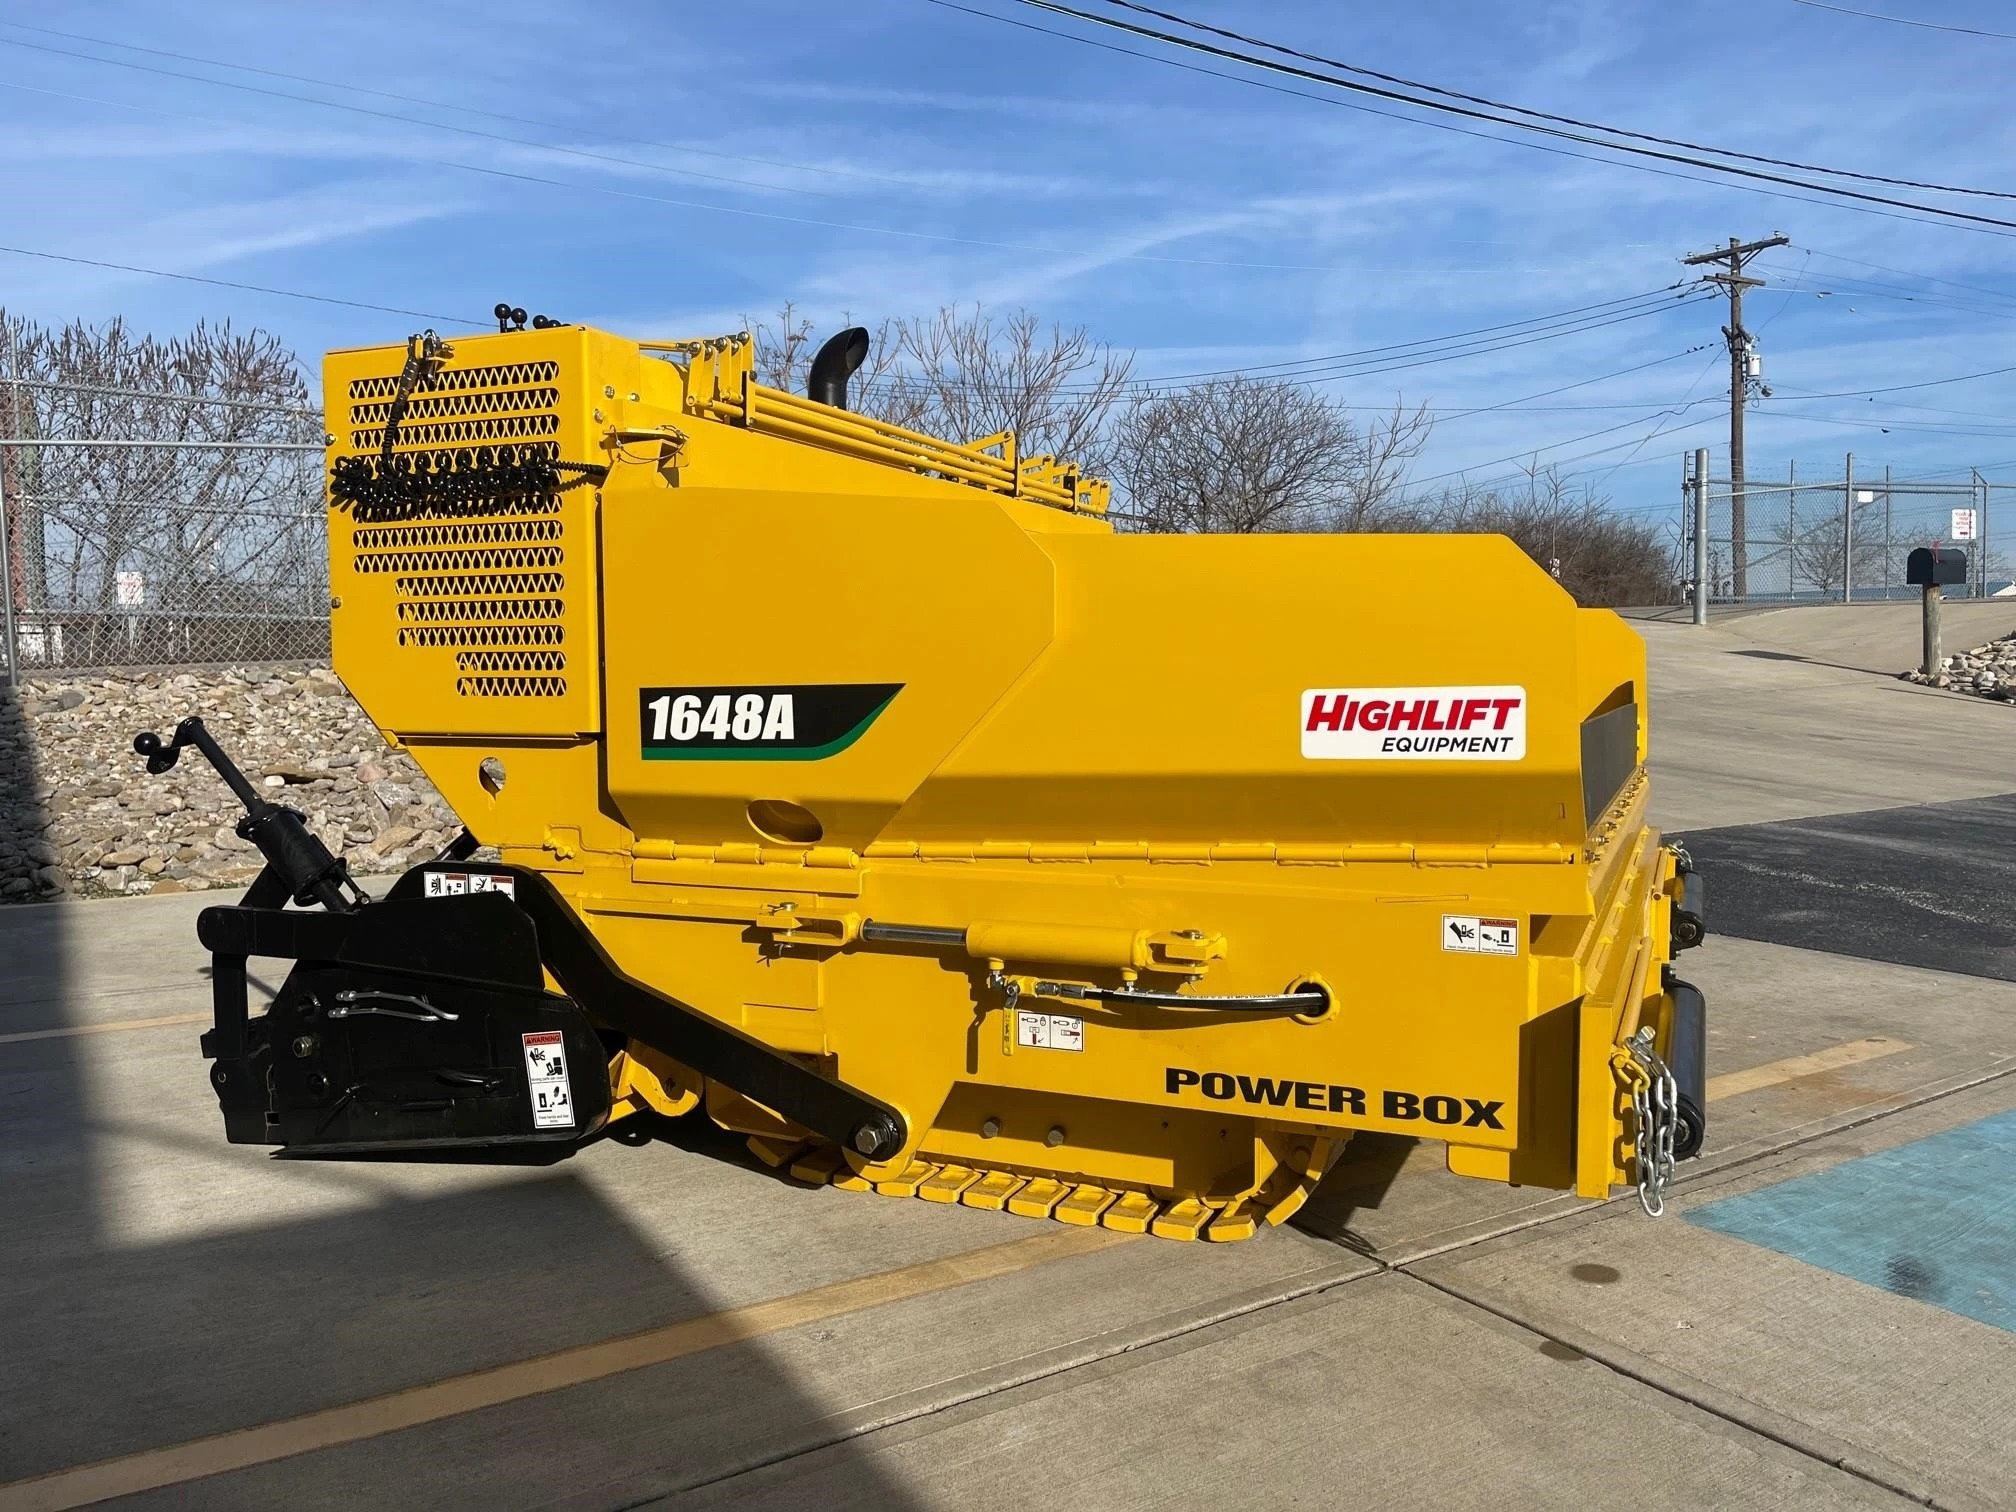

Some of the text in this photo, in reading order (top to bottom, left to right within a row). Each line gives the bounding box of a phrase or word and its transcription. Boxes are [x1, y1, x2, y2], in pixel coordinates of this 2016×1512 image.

[648, 694, 795, 741] 1648A
[1306, 694, 1522, 732] HIGHLIFT
[1381, 736, 1514, 753] EQUIPMENT
[531, 1034, 560, 1043] WARNING
[1165, 1067, 1506, 1131] POWER BOX
